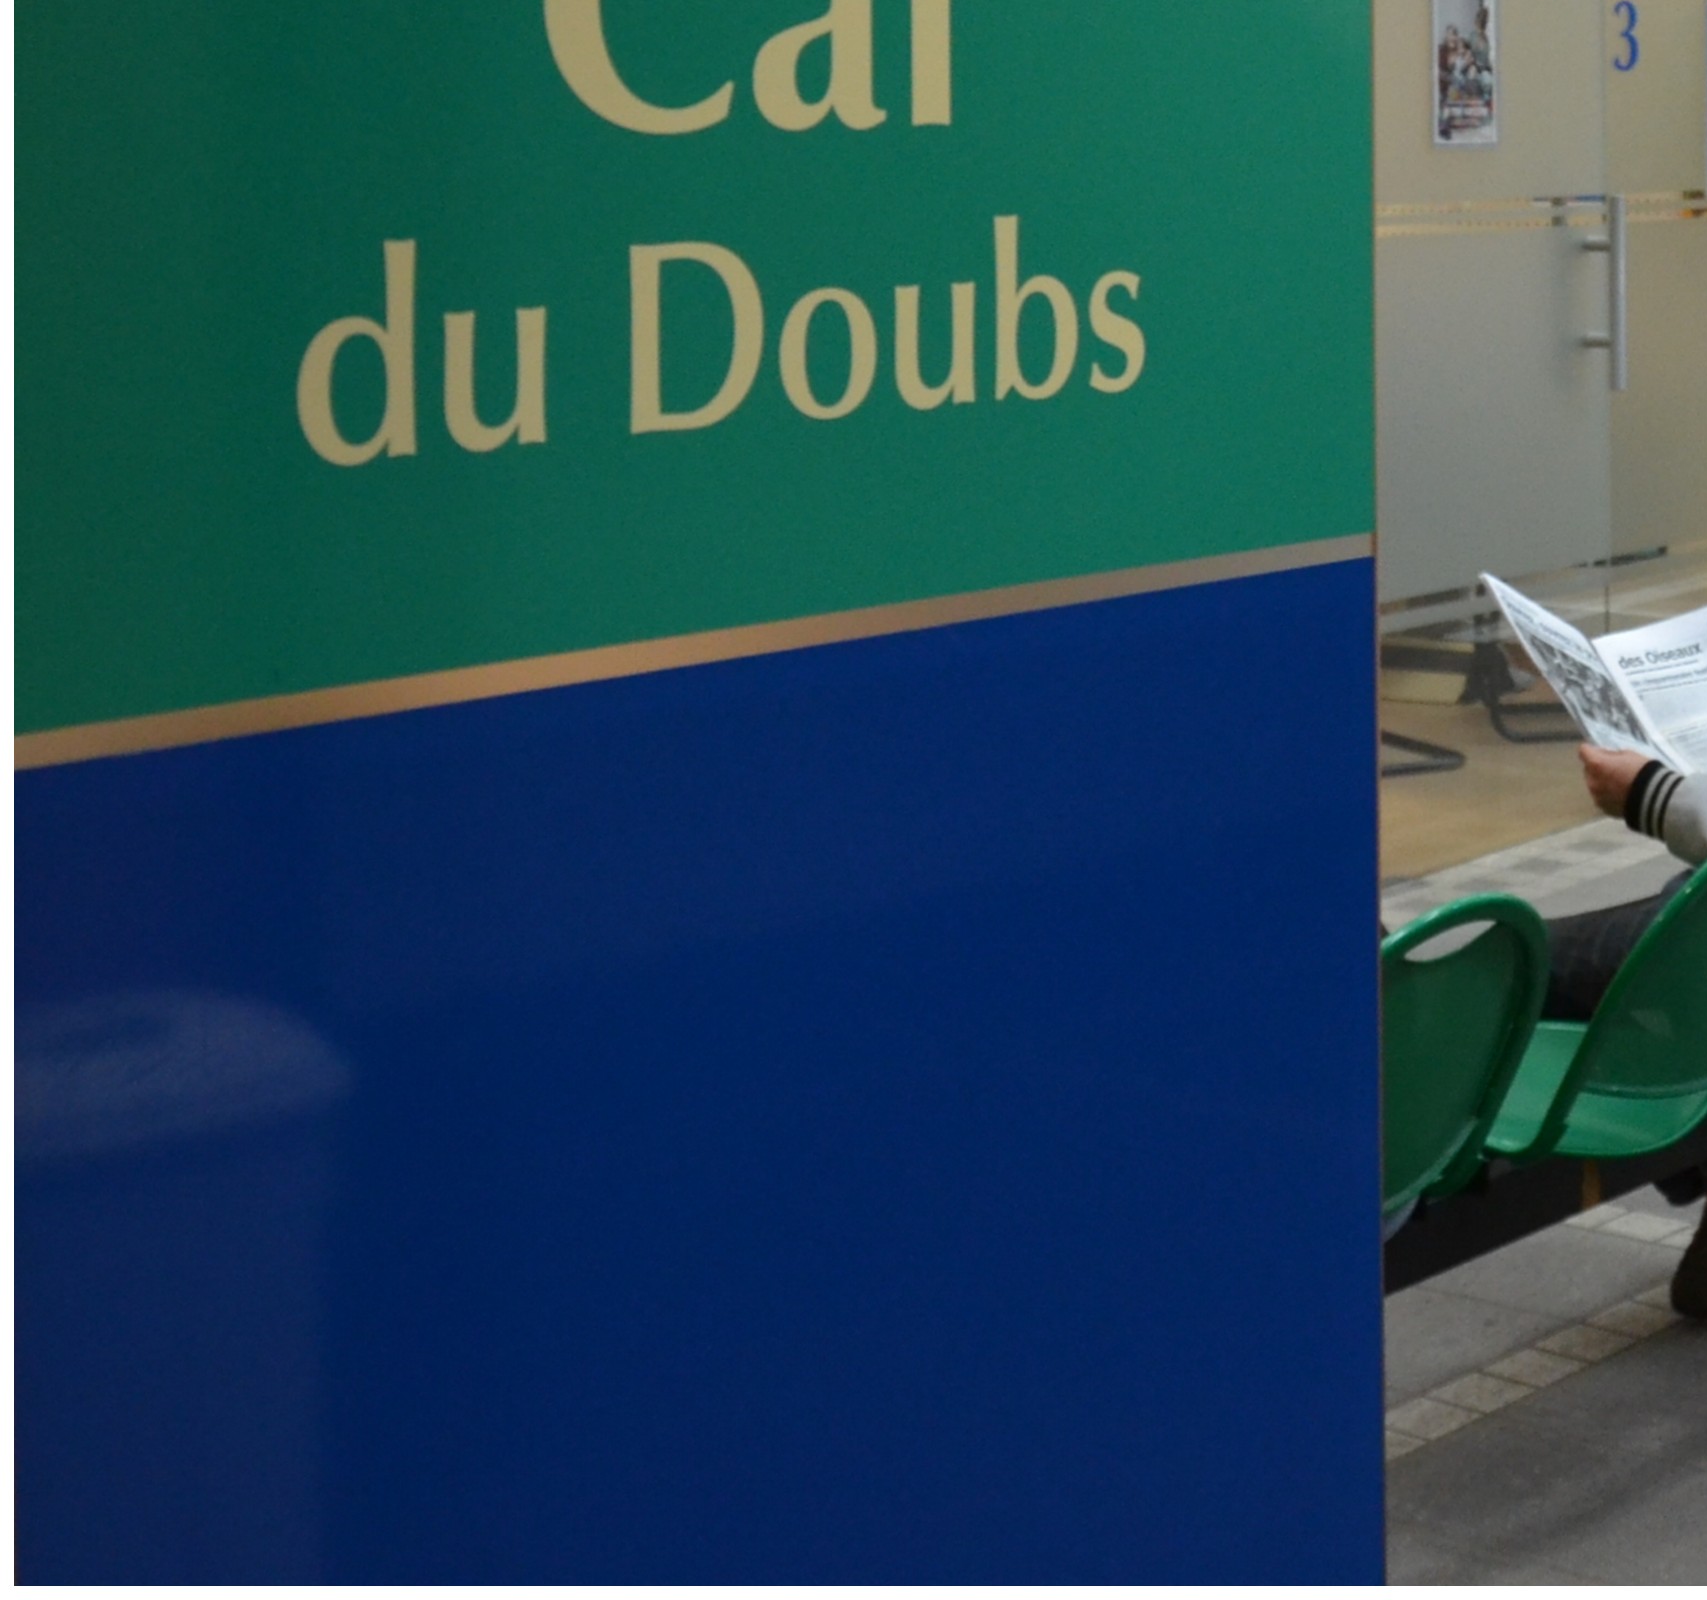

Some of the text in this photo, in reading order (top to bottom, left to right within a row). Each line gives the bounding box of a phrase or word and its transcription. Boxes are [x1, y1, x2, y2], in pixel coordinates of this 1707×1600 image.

[1613, 0, 1640, 73] 3
[296, 213, 1148, 467] du Doubs
